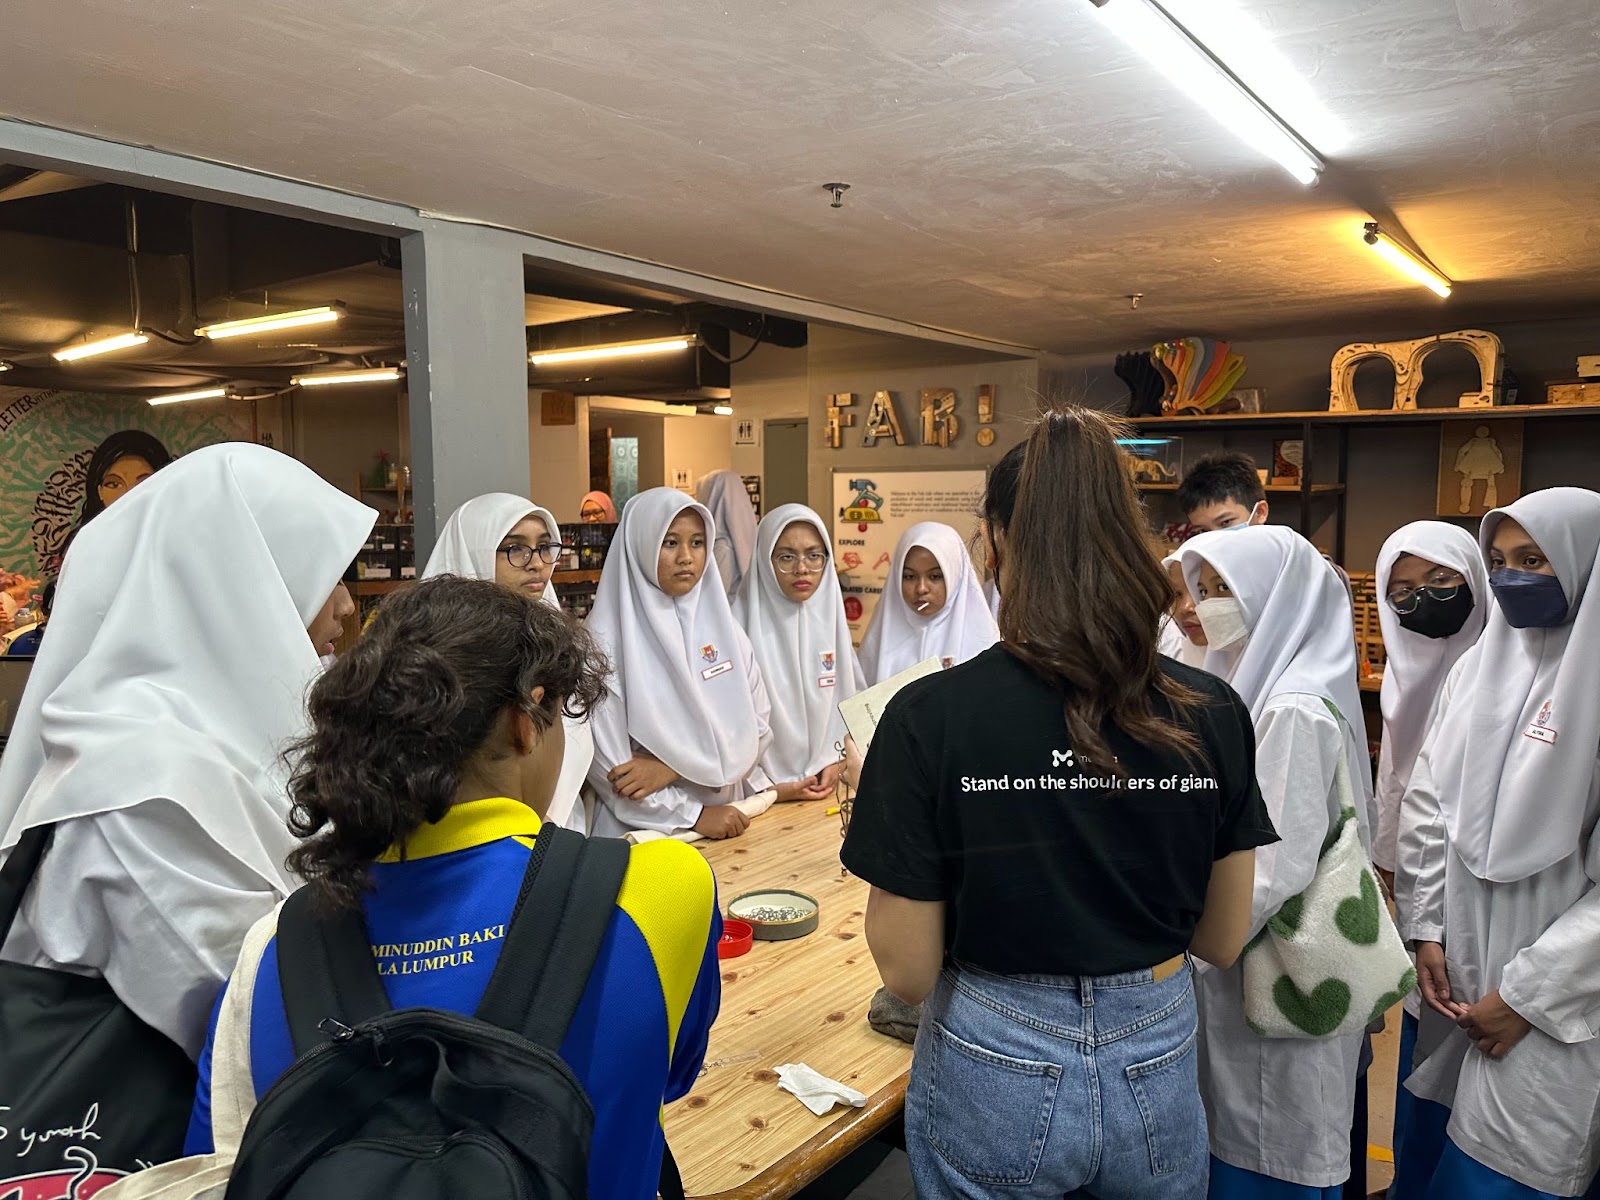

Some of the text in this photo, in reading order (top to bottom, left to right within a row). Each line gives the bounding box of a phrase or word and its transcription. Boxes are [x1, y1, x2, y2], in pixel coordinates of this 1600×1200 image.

[823, 384, 997, 449] FAB!
[961, 775, 1009, 792] Stand
[1013, 777, 1035, 790] on
[1039, 775, 1066, 790] the
[1159, 774, 1178, 789] of
[459, 924, 505, 947] BAKI
[377, 950, 474, 975] LA LUMPUR
